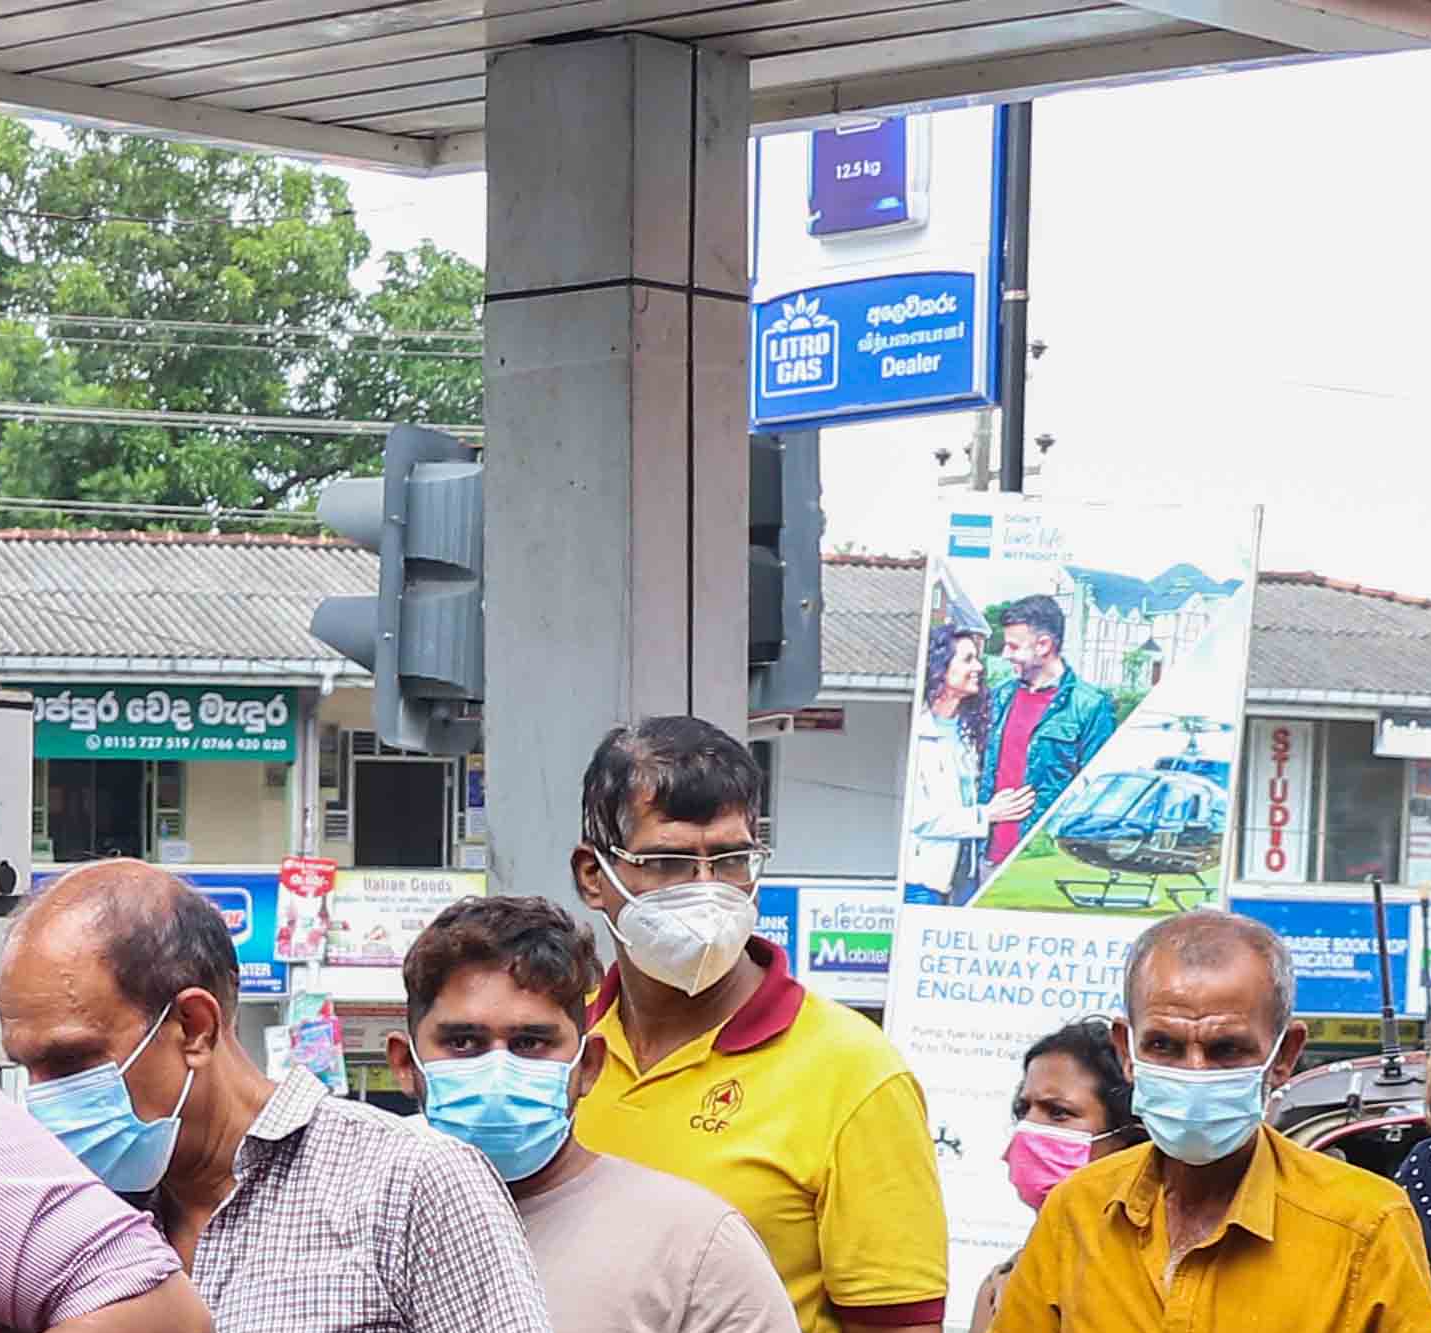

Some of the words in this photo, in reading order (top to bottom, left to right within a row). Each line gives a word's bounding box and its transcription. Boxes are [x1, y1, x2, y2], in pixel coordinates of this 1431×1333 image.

[836, 162, 861, 179] 12.5
[864, 160, 881, 177] kg
[770, 332, 830, 361] LITRO
[777, 358, 822, 384] GAS
[882, 353, 940, 378] Dealer
[104, 736, 135, 749] 0115
[139, 736, 162, 749] 727
[166, 737, 189, 750] 519
[1264, 727, 1292, 873] STUDIO
[810, 909, 895, 930] Telecom
[815, 938, 890, 965] Mobitel
[922, 929, 979, 950] FUEL
[988, 933, 1020, 952] UP
[1028, 936, 1075, 957] FOR
[1082, 941, 1098, 958] A
[1107, 942, 1135, 960] FA
[920, 955, 1042, 980] GETAWAY
[1047, 964, 1077, 982] AT
[1086, 967, 1124, 985] LIT
[917, 980, 1034, 1006] ENGLAND
[1041, 988, 1124, 1010] COTTA
